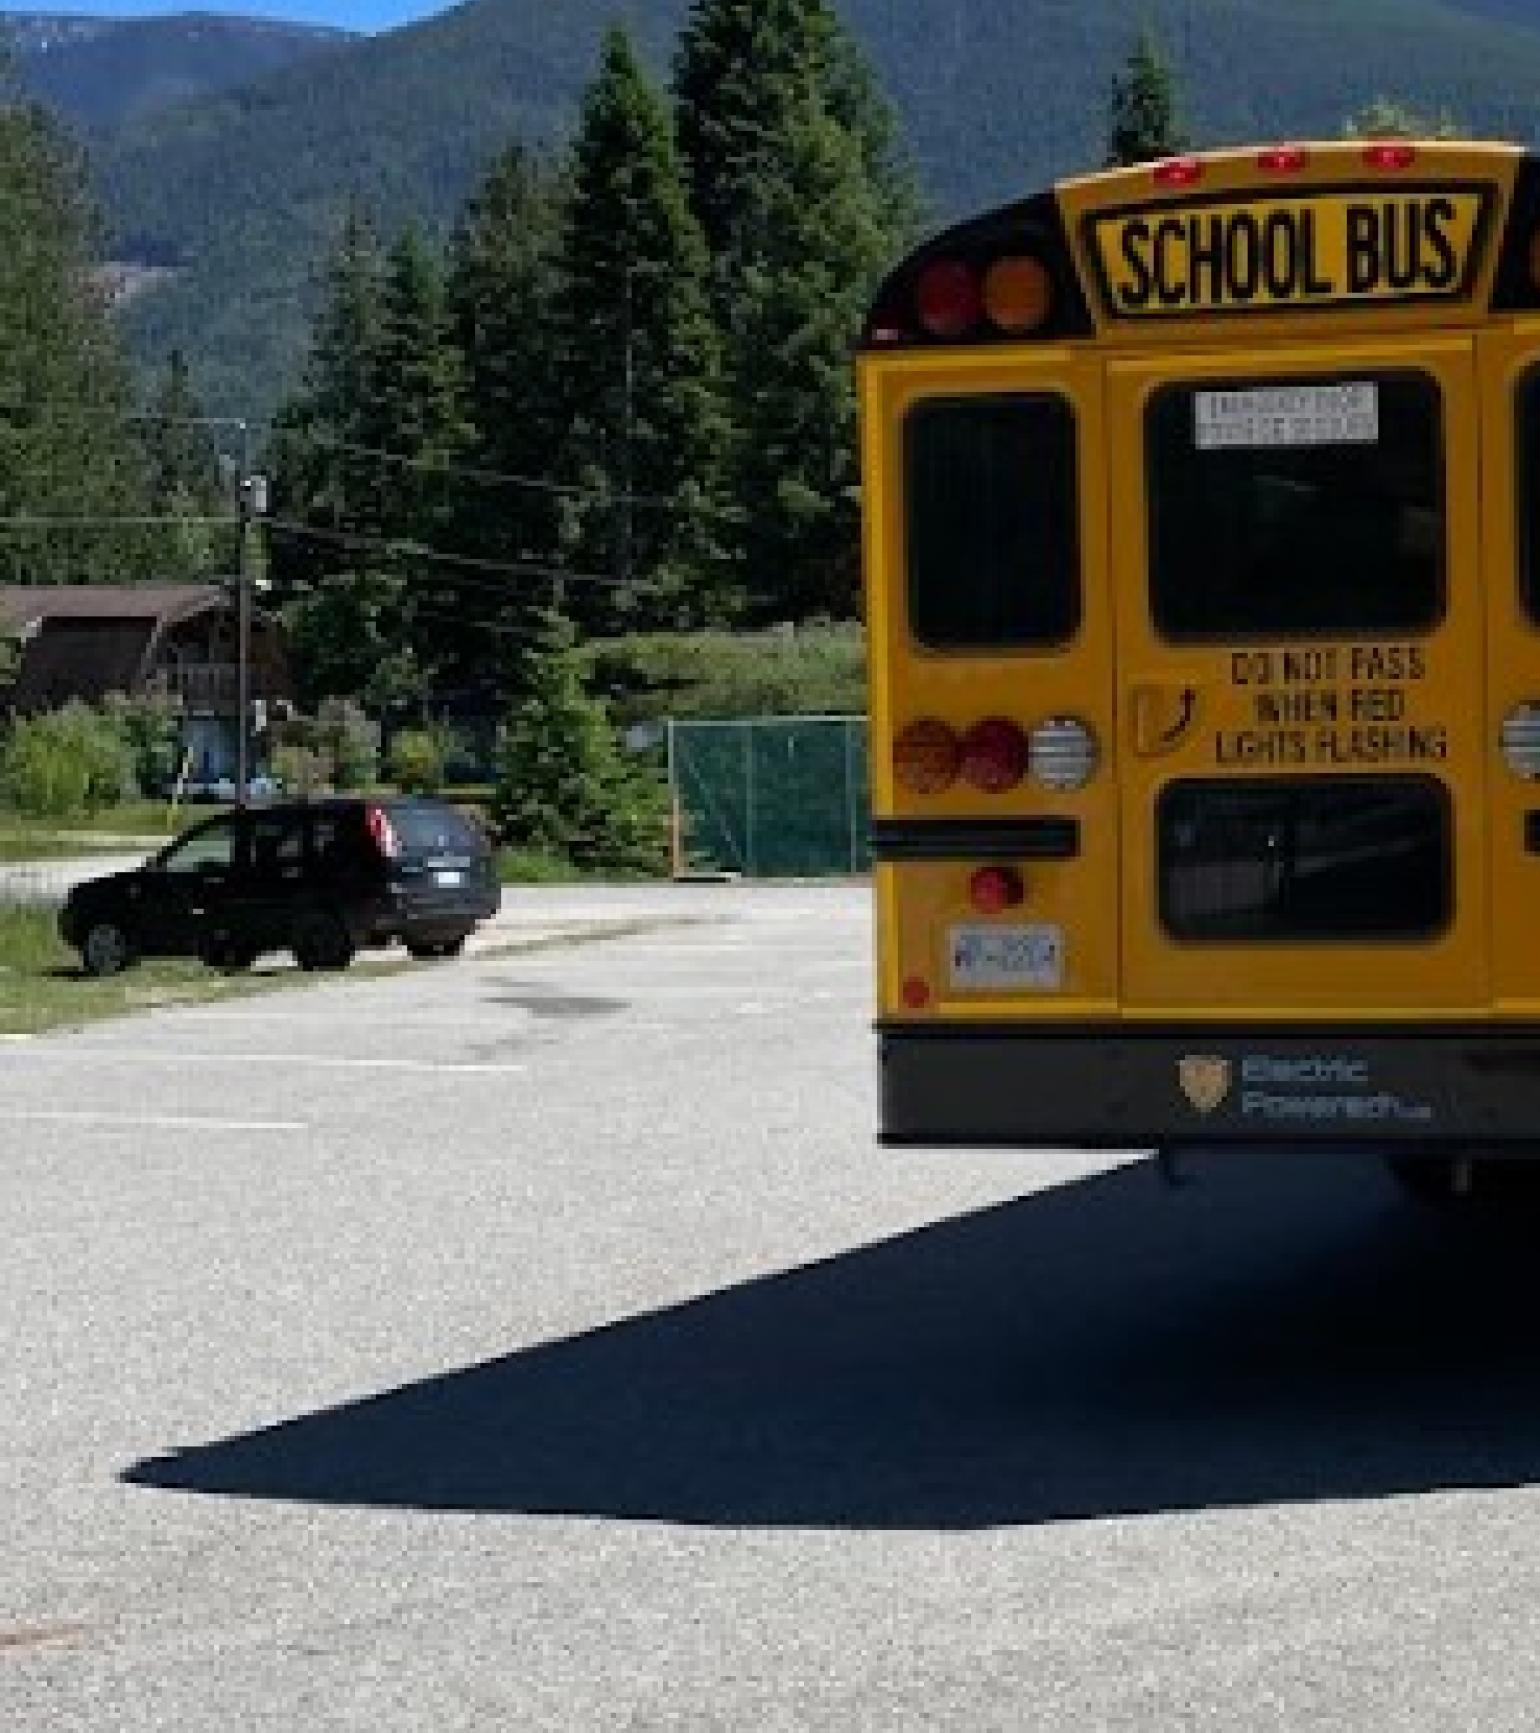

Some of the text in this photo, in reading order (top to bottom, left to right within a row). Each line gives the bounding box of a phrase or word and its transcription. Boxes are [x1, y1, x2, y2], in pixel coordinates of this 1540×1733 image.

[1119, 198, 1457, 306] SCHOOL BUS
[1231, 647, 1427, 685] DO NOT PASS
[1253, 689, 1406, 722] WHEN RED
[1215, 725, 1448, 764] LIGHTS FLASHING
[1241, 1055, 1369, 1083] Electric
